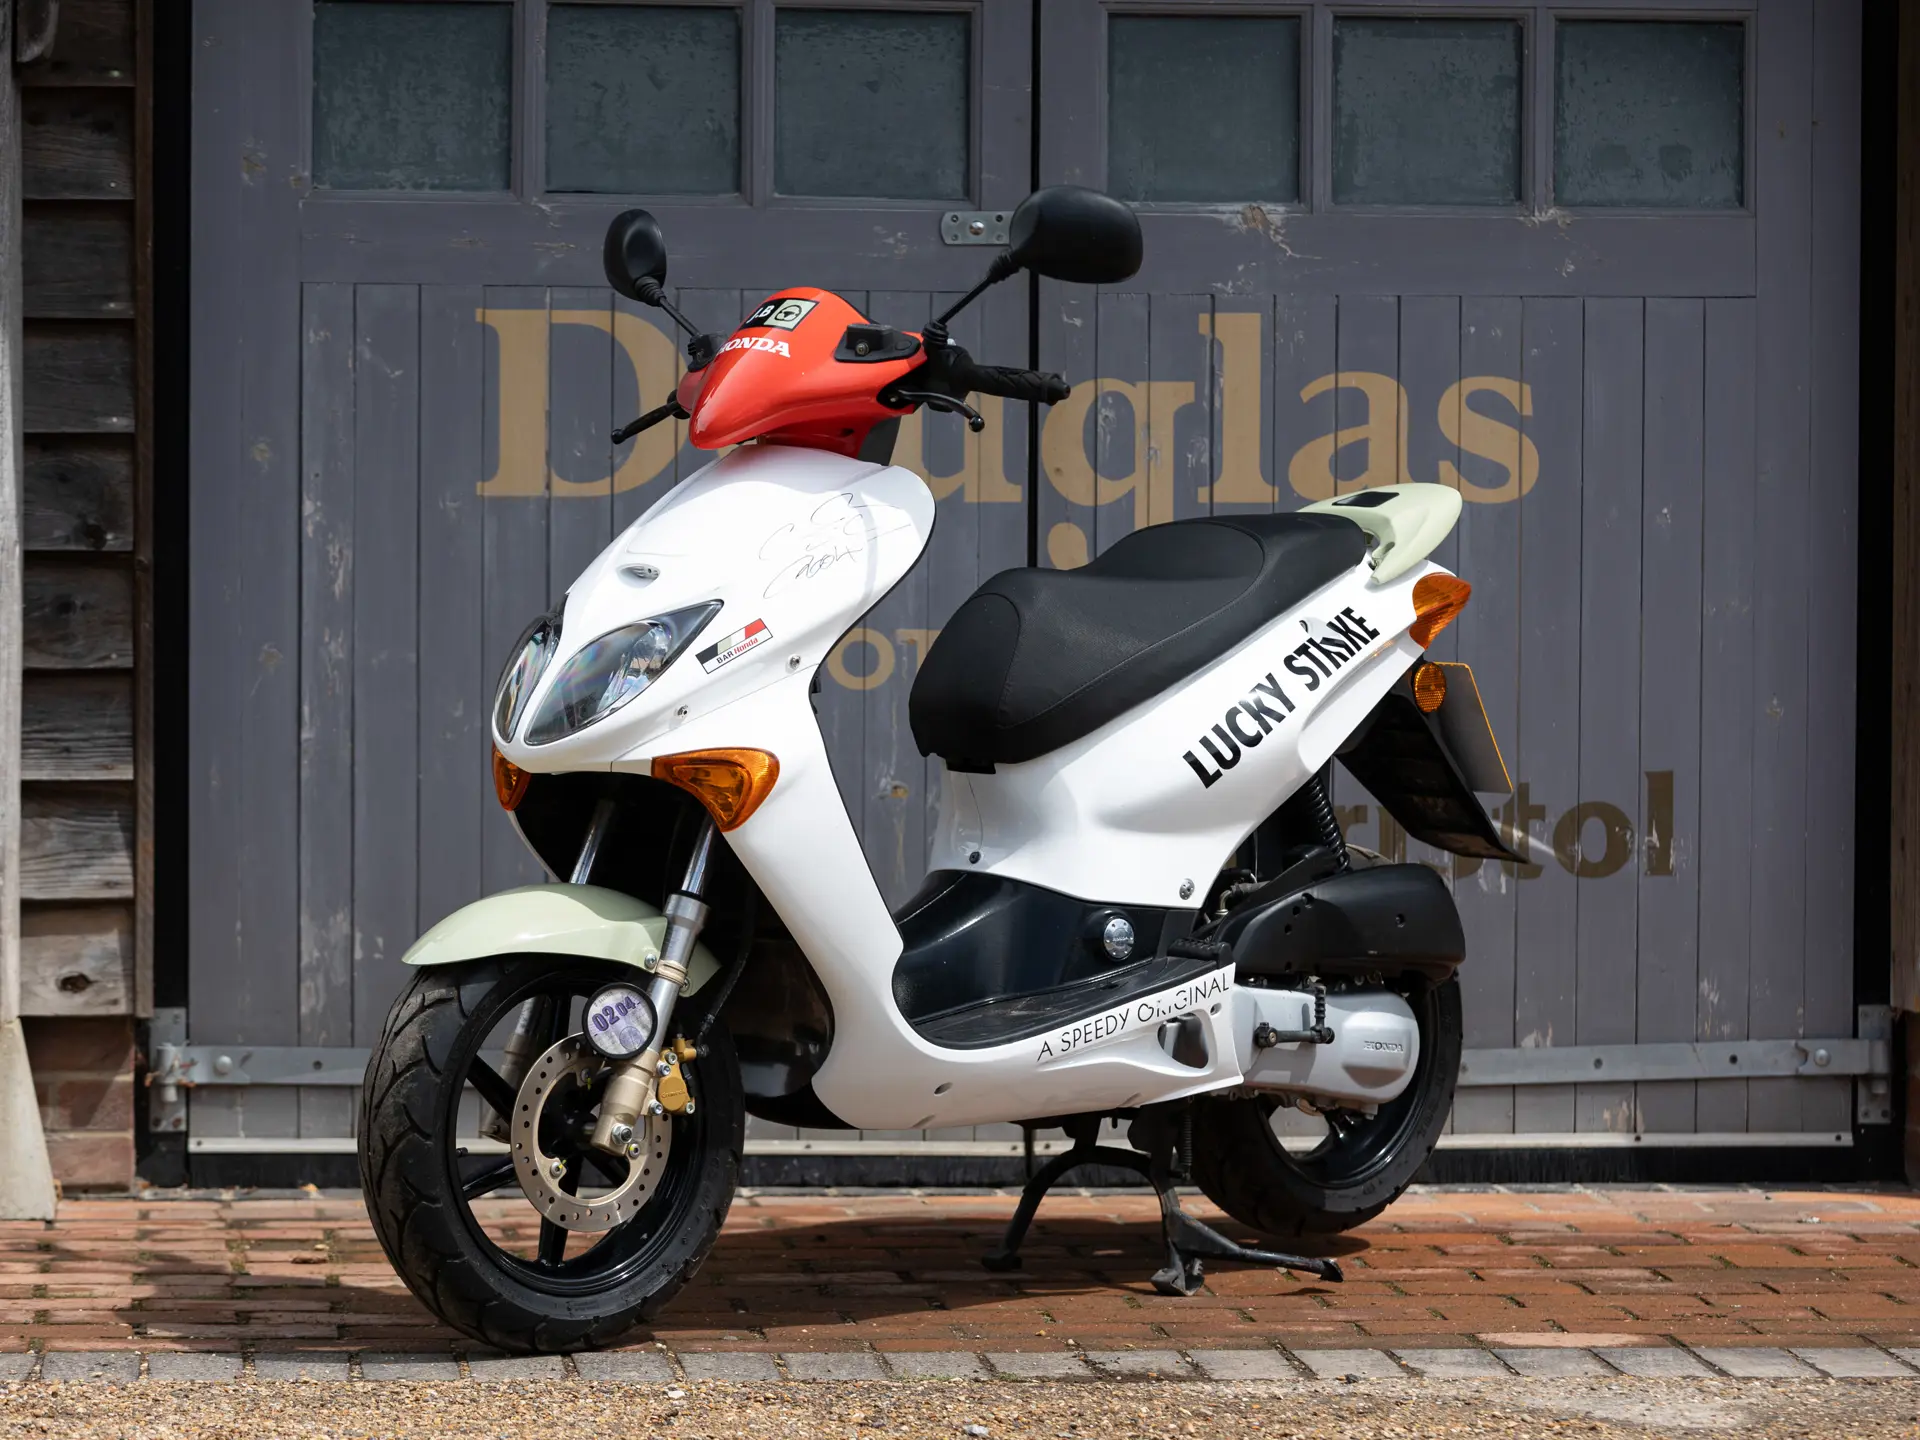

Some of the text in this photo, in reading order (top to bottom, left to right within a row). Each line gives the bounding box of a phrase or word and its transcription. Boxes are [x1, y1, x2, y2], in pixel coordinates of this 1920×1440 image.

[476, 308, 1540, 570] Duglas
[716, 637, 759, 664] BAR Honda
[1182, 672, 1297, 789] LUCKY
[1334, 770, 1674, 880] ritol
[592, 1005, 620, 1031] 02
[615, 996, 636, 1017] 04
[1037, 1040, 1053, 1061] A
[1061, 1008, 1130, 1052] SPEEDY
